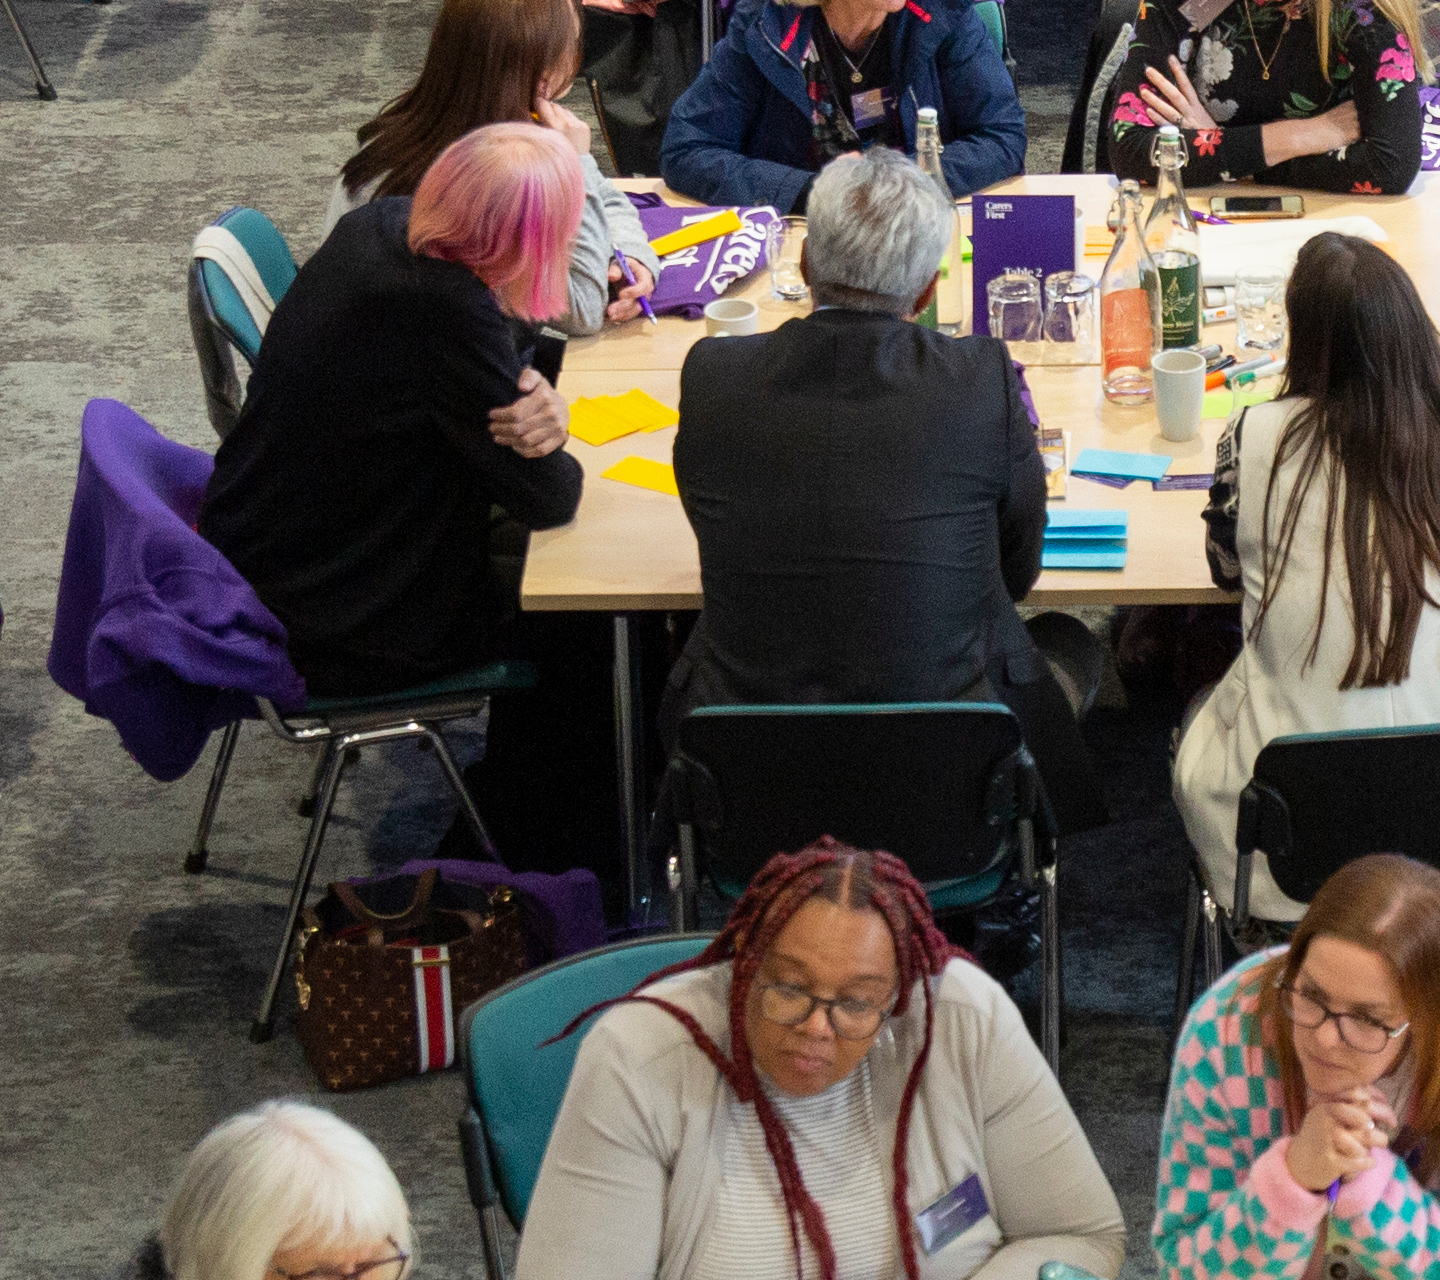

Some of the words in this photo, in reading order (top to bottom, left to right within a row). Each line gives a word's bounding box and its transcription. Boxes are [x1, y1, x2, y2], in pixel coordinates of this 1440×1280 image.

[985, 202, 1013, 210] Carers
[985, 211, 1005, 220] First
[1004, 267, 1034, 276] Table
[1035, 268, 1043, 277] 2
